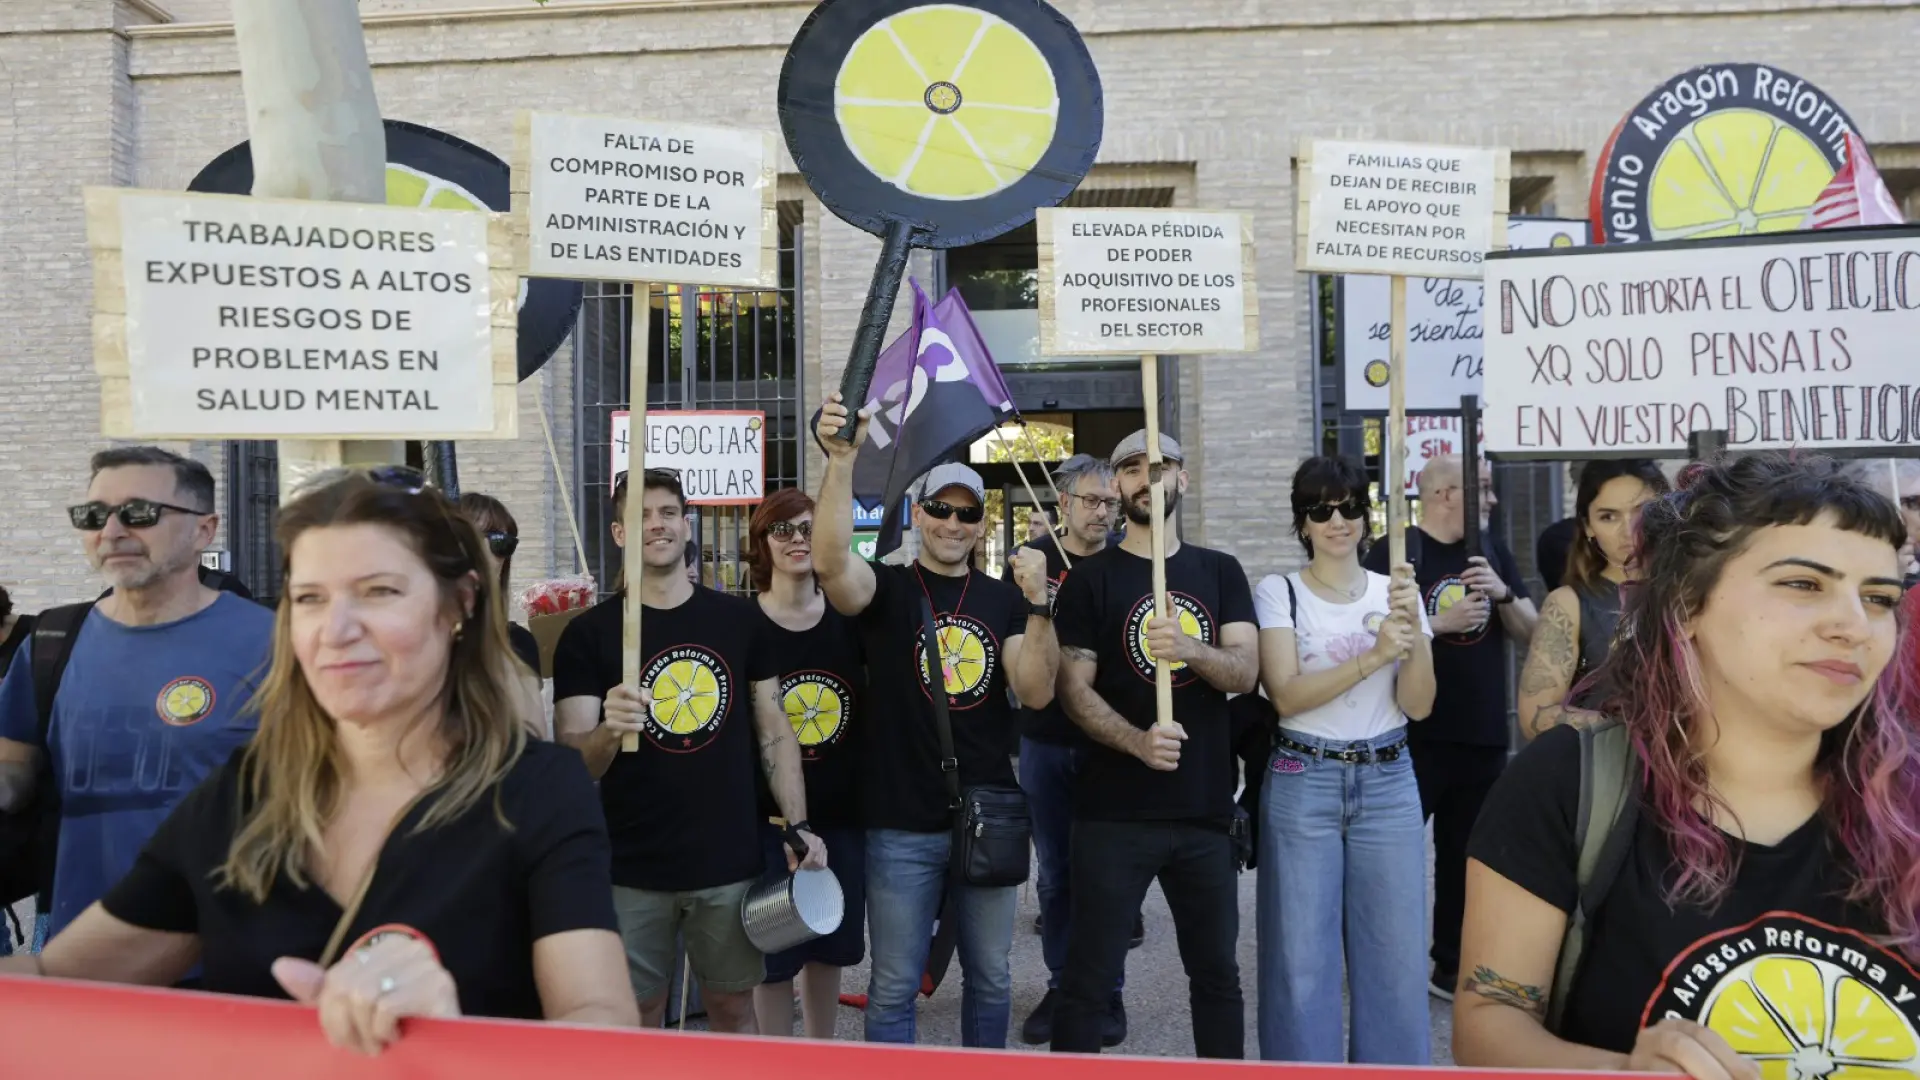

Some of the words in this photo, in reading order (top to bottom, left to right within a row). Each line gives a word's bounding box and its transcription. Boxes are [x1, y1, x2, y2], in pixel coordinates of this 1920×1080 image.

[604, 133, 661, 152] FALTA
[668, 139, 694, 154] DE
[1348, 153, 1422, 169] FAMILIAS
[1426, 158, 1460, 172] QUE
[1610, 154, 1644, 244] venio
[1632, 67, 1740, 140] Aragón
[550, 157, 697, 183] COMPROMISO
[703, 169, 745, 187] POR
[1330, 175, 1381, 189] DEJAN
[1386, 178, 1407, 191] DE
[1411, 180, 1477, 195] RECIBIR
[585, 187, 648, 207] PARTE
[654, 193, 681, 208] DE
[687, 195, 710, 210] LA
[1344, 198, 1362, 211] EL
[1366, 199, 1421, 214] APOYO
[1426, 203, 1460, 217] QUE
[183, 220, 435, 252] TRABAJADORES
[546, 213, 728, 239] ADMINISTRACIÓN
[734, 225, 746, 240] Y
[1072, 223, 1147, 237] ELEVADA
[1152, 221, 1224, 239] PÉRDIDA
[1336, 220, 1427, 237] NECESITAN
[1432, 225, 1465, 240] POR
[550, 243, 578, 260] DE
[584, 244, 622, 261] LAS
[628, 247, 742, 268] ENTIDADES
[1107, 248, 1130, 261] DE
[1134, 248, 1192, 262] PODER
[1316, 242, 1362, 257] FALTA
[1366, 245, 1388, 258] DE
[1392, 247, 1483, 263] RECURSOS
[146, 260, 342, 289] EXPUESTOS
[350, 270, 370, 290] A
[378, 271, 472, 294] ALTOS
[1062, 273, 1173, 288] ADQUISITIVO
[1178, 273, 1200, 287] DE
[1204, 273, 1235, 287] LOS
[1081, 298, 1221, 312] PROFESIONALES
[1500, 275, 1577, 334] NO
[1582, 281, 1612, 318] OS
[1621, 276, 1712, 315] IMPORTA
[1722, 276, 1752, 310] EL
[219, 305, 362, 331] RIESGOS
[372, 309, 412, 331] DE
[1101, 323, 1133, 337] DEL
[1137, 322, 1203, 337] SECTOR
[192, 347, 389, 371] PROBLEMAS
[399, 349, 439, 371] EN
[1527, 343, 1573, 386] XQ
[1586, 336, 1663, 384] SOLO
[1691, 327, 1852, 377] PENSAIS
[197, 388, 306, 411] SALUD
[315, 388, 439, 411] MENTAL
[1518, 404, 1562, 447] EN
[680, 468, 758, 496] CULAR
[672, 649, 715, 667] Reforma
[1672, 936, 1757, 1008] Aragón
[1763, 926, 1889, 985] Reforma
[1892, 983, 1918, 1004] y
